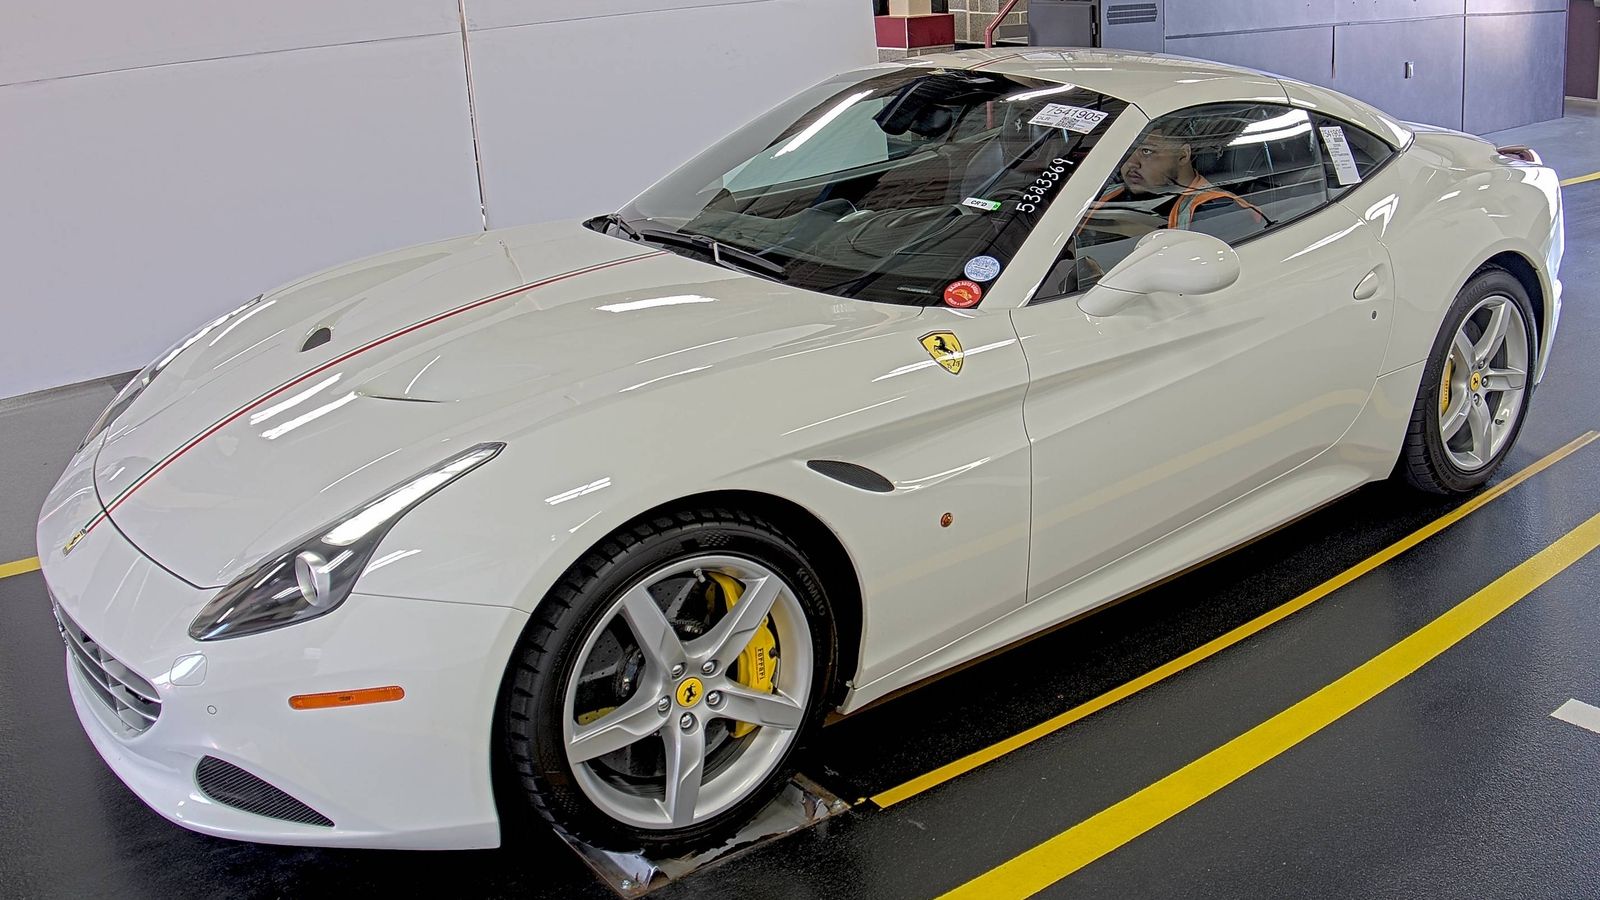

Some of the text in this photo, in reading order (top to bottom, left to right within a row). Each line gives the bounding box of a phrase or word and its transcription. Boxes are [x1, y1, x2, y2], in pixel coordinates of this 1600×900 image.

[1046, 105, 1104, 122] 7541905
[1015, 157, 1074, 213] 5323369
[796, 567, 826, 616] KUMHO
